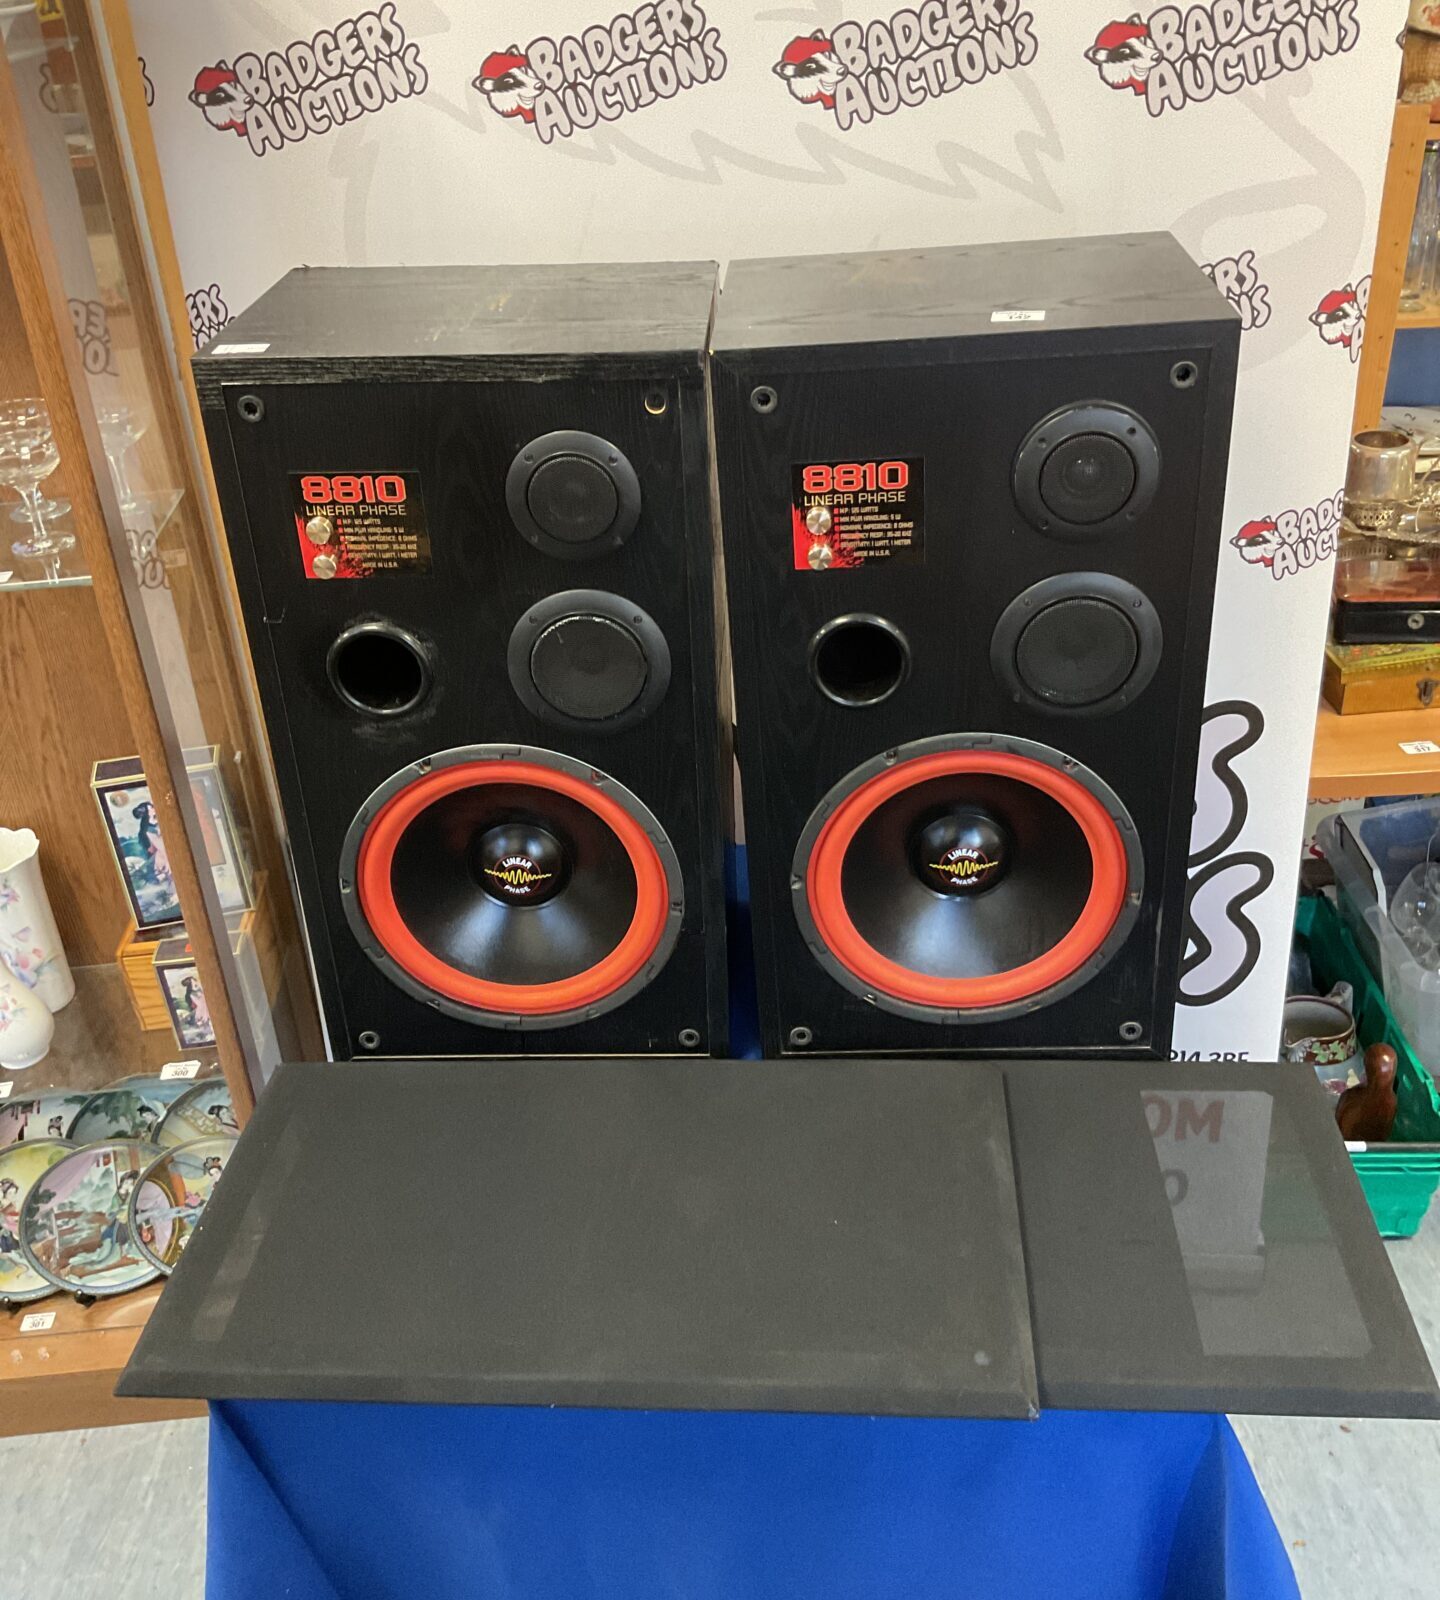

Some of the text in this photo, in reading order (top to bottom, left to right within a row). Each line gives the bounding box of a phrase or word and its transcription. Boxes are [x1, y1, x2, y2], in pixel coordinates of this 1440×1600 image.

[233, 2, 405, 106] BADGERS
[525, 0, 706, 92] BADGERS
[1145, 0, 1360, 118] AUCTIONS
[1147, 0, 1341, 63] BADG
[245, 43, 429, 157] AUCTIONS
[534, 27, 728, 145] AUCTIONS
[834, 11, 1039, 131] AUCTIONS
[301, 475, 407, 503] 8810
[802, 461, 909, 494] 8810
[804, 491, 906, 507] LINEAR PHASE
[305, 504, 407, 516] LINEAR PHASE
[1276, 488, 1345, 546] BADG
[1272, 520, 1339, 581] AUCT
[502, 857, 533, 870] LINEAR
[947, 848, 979, 861] LINEAR
[504, 884, 531, 894] PHASE
